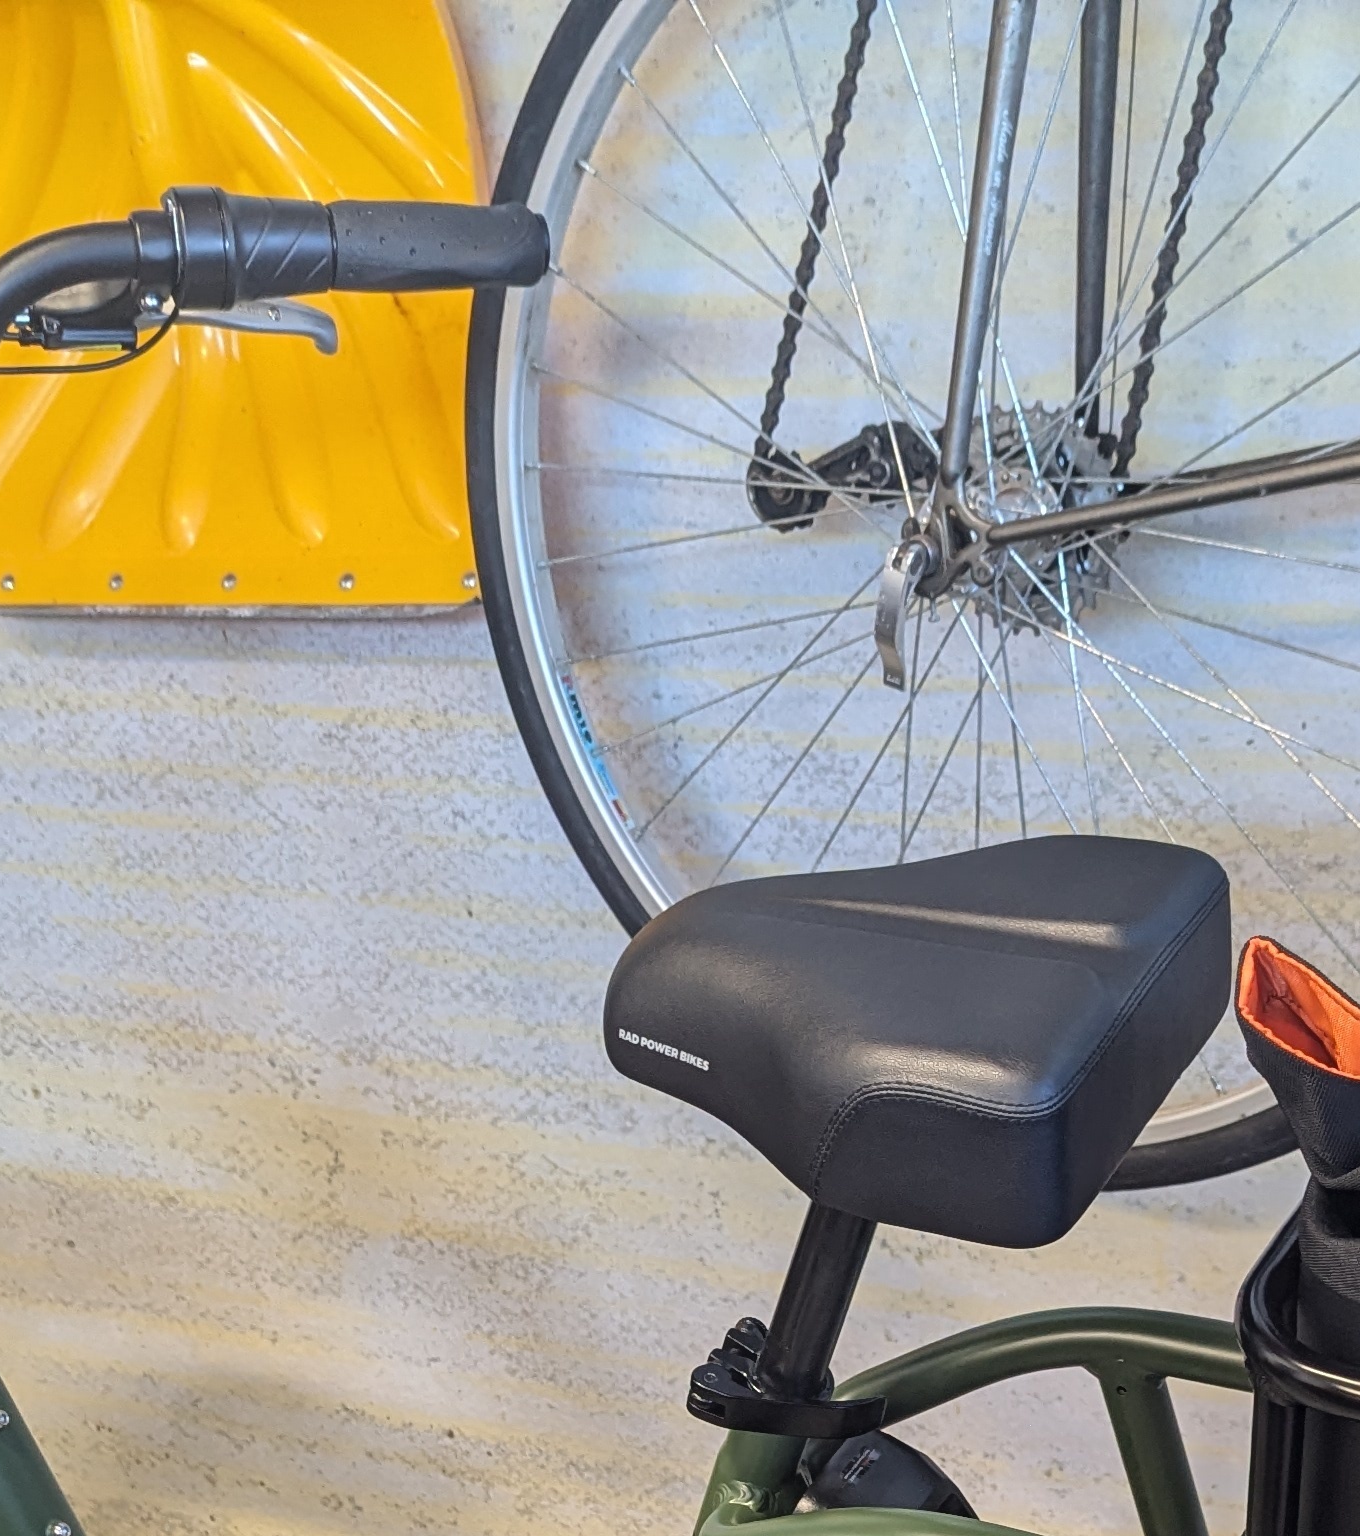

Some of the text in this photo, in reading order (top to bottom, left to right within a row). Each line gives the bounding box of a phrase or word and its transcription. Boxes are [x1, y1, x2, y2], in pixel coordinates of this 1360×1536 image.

[619, 1028, 710, 1072] RAD POWER BIKES
